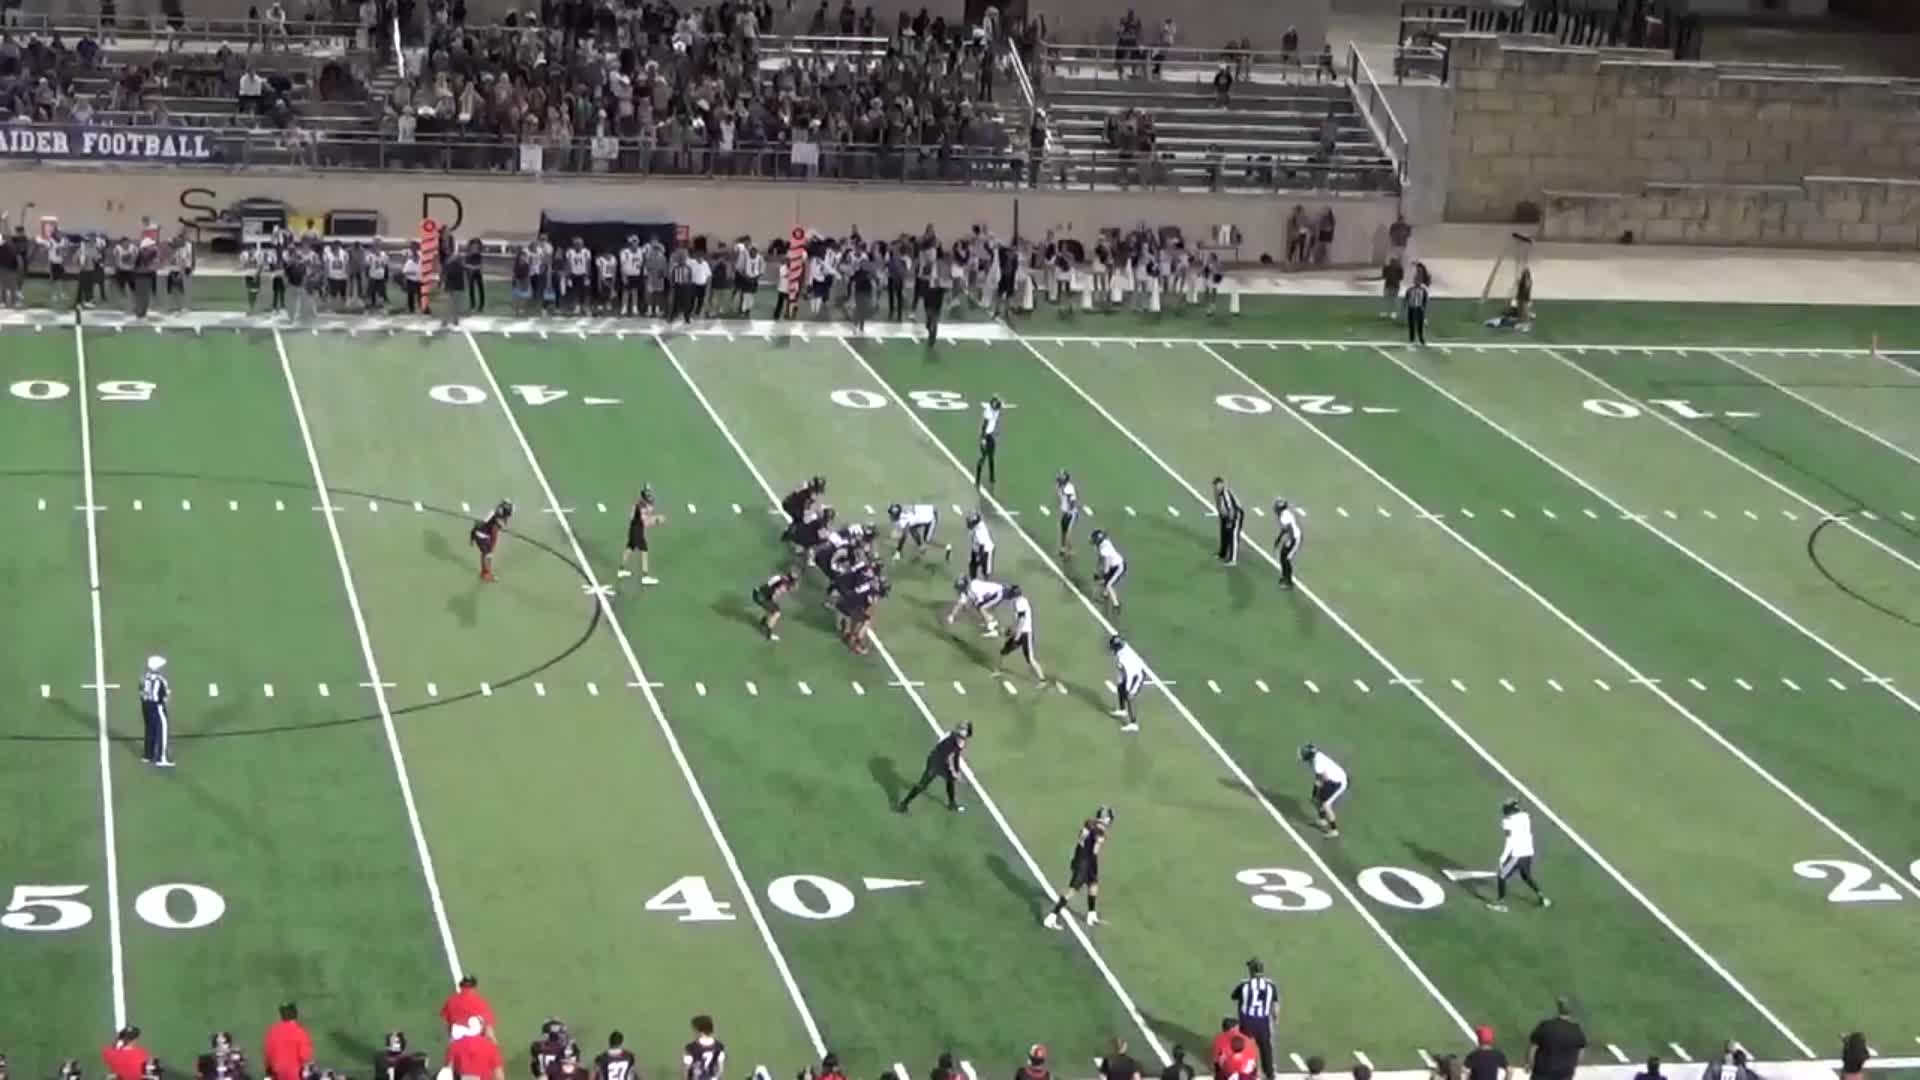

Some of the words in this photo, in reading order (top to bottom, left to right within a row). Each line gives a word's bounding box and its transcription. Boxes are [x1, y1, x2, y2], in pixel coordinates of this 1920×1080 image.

[82, 133, 210, 157] FOOTBALL
[0, 884, 226, 931] 50
[644, 874, 855, 922] 40
[1234, 866, 1445, 912] 30
[607, 1061, 629, 1080] 27
